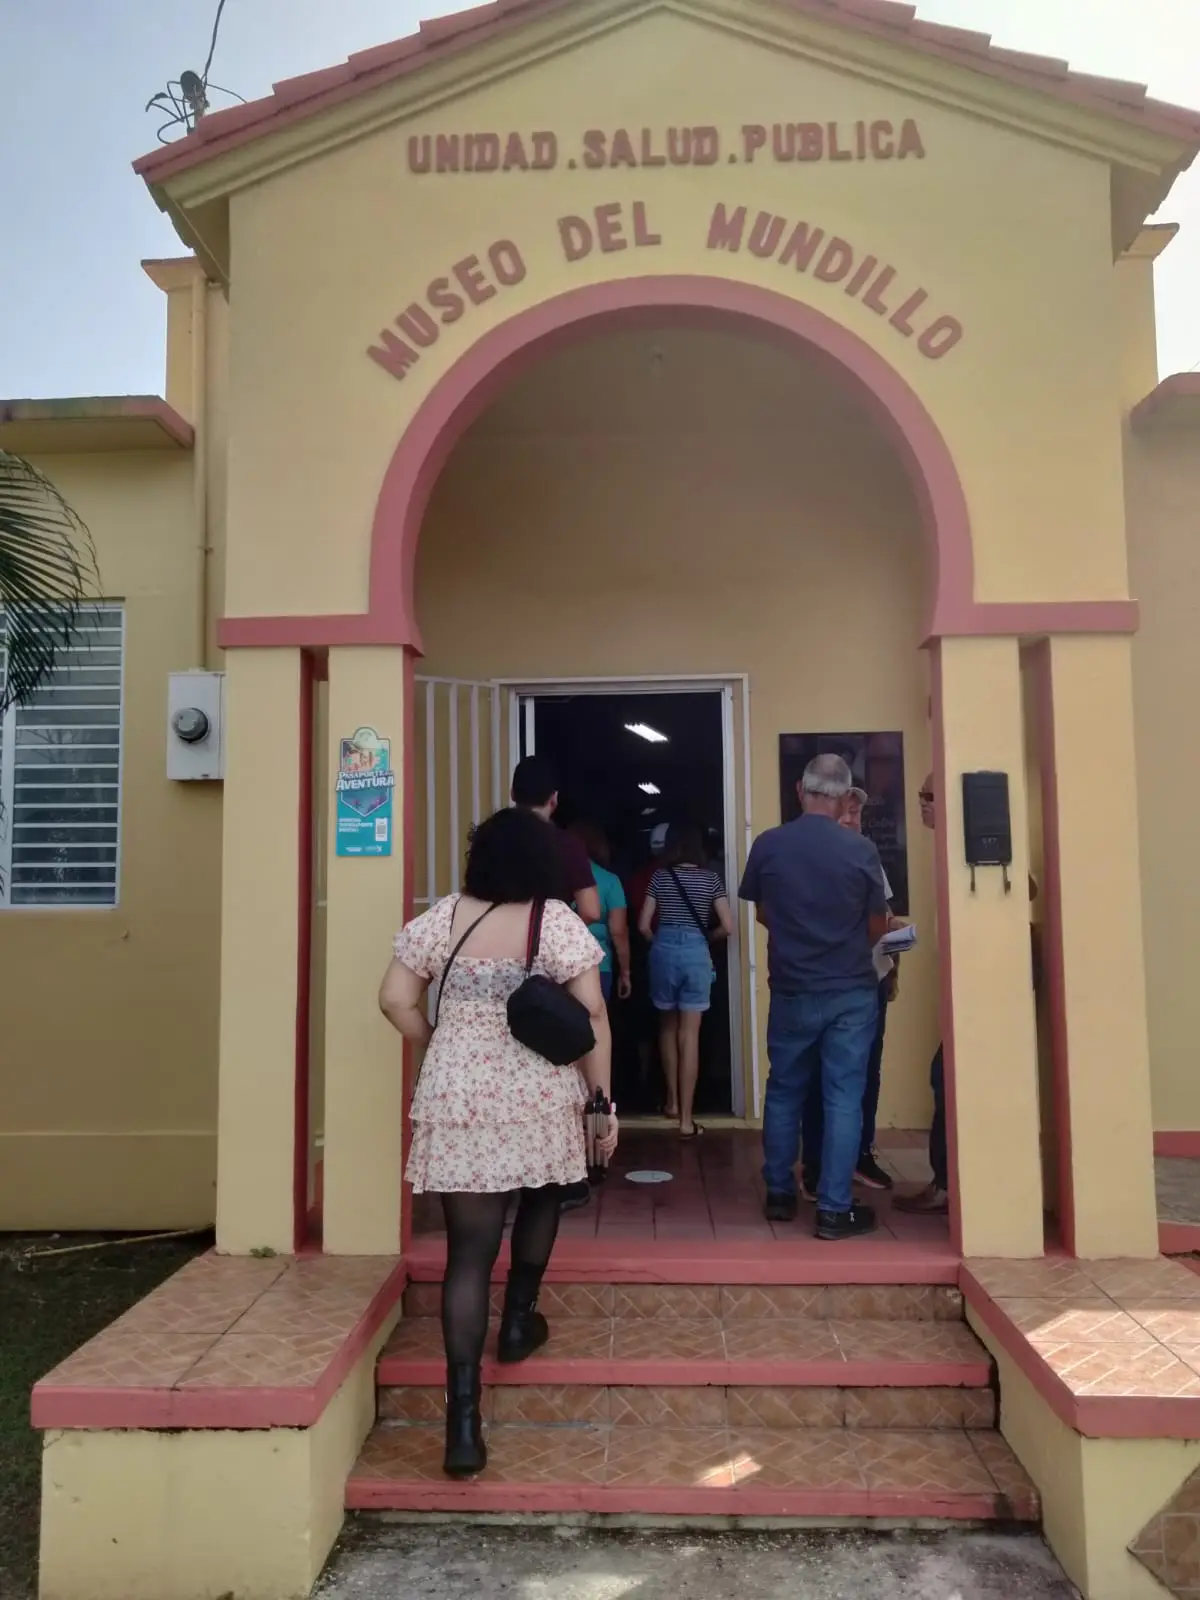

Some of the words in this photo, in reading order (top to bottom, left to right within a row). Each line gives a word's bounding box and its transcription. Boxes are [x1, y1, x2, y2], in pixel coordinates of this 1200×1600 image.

[408, 131, 557, 173] UNIDAD
[366, 239, 527, 381] MUSEO
[557, 200, 662, 262] DEL
[706, 202, 963, 360] MUNDILLO
[335, 775, 394, 791] AVENTURA
